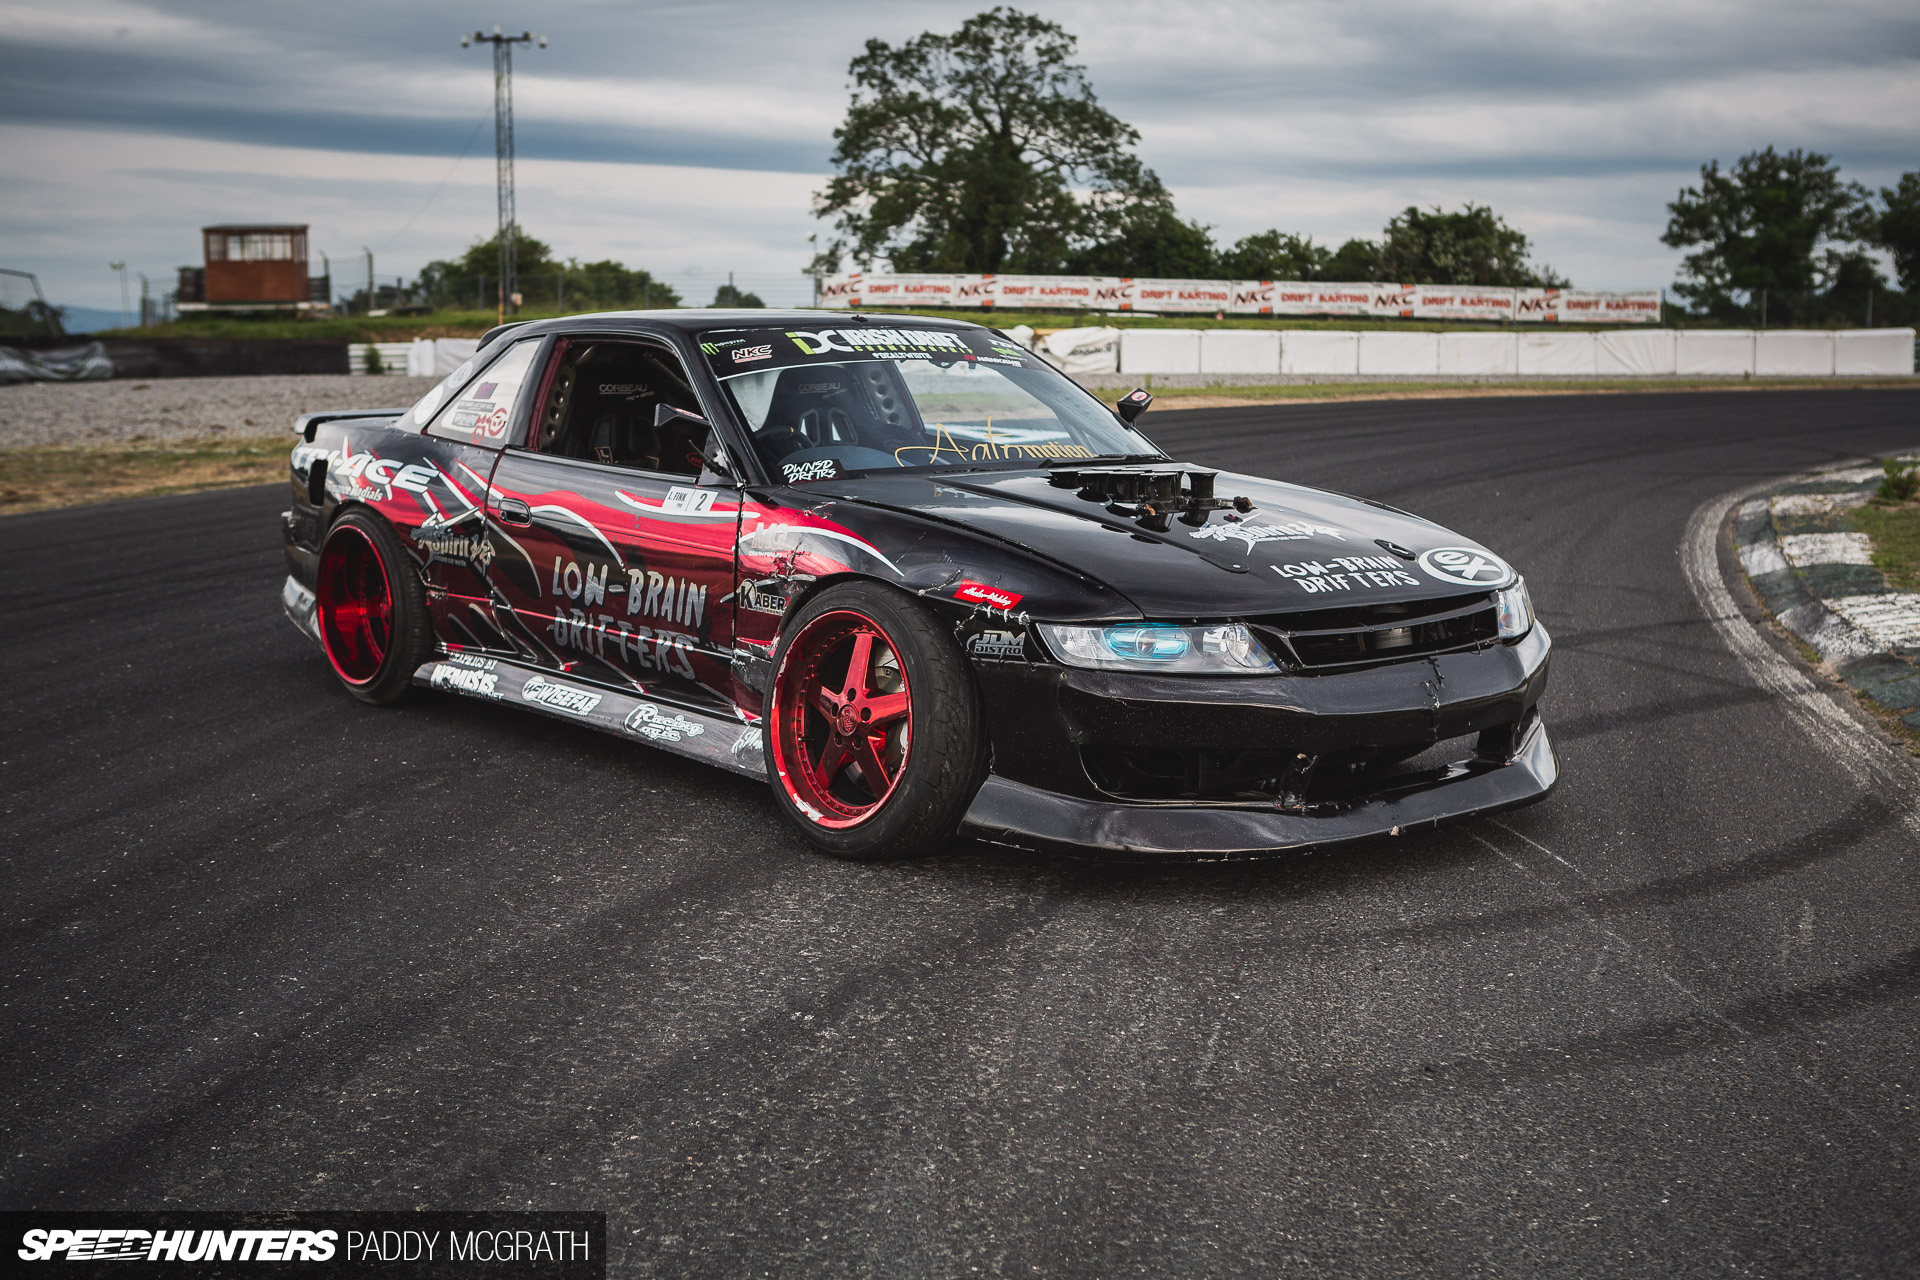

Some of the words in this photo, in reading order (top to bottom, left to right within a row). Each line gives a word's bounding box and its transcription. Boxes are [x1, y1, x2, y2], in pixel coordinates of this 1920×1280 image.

[868, 284, 898, 294] DRIFT
[904, 285, 951, 295] KARTING
[1003, 286, 1034, 296] DRIFT
[1040, 287, 1089, 297] KARTING
[1140, 290, 1172, 300] DRIFT
[1178, 290, 1228, 301] KARTING
[1281, 292, 1313, 303] DRIFT
[1318, 293, 1369, 304] KARTING
[1422, 296, 1454, 307] DRIFT
[1460, 297, 1511, 309] KARTING
[1566, 299, 1598, 311] DRIFT
[1606, 299, 1658, 313] KARTING
[898, 330, 968, 349] DRIFT
[733, 345, 773, 360] NKC
[854, 345, 973, 354] CHAMPIONSHIP
[599, 384, 648, 393] CORBEAU
[695, 493, 708, 511] 2
[1270, 556, 1403, 577] LOW-BRAIN
[1293, 570, 1420, 593] DRIFTERS
[553, 556, 707, 628] LOW-BRAIN
[547, 605, 699, 680] DRIFTERS
[976, 645, 1022, 655] DISTRO
[537, 684, 600, 712] WISEFAB
[635, 706, 705, 737] Racing
